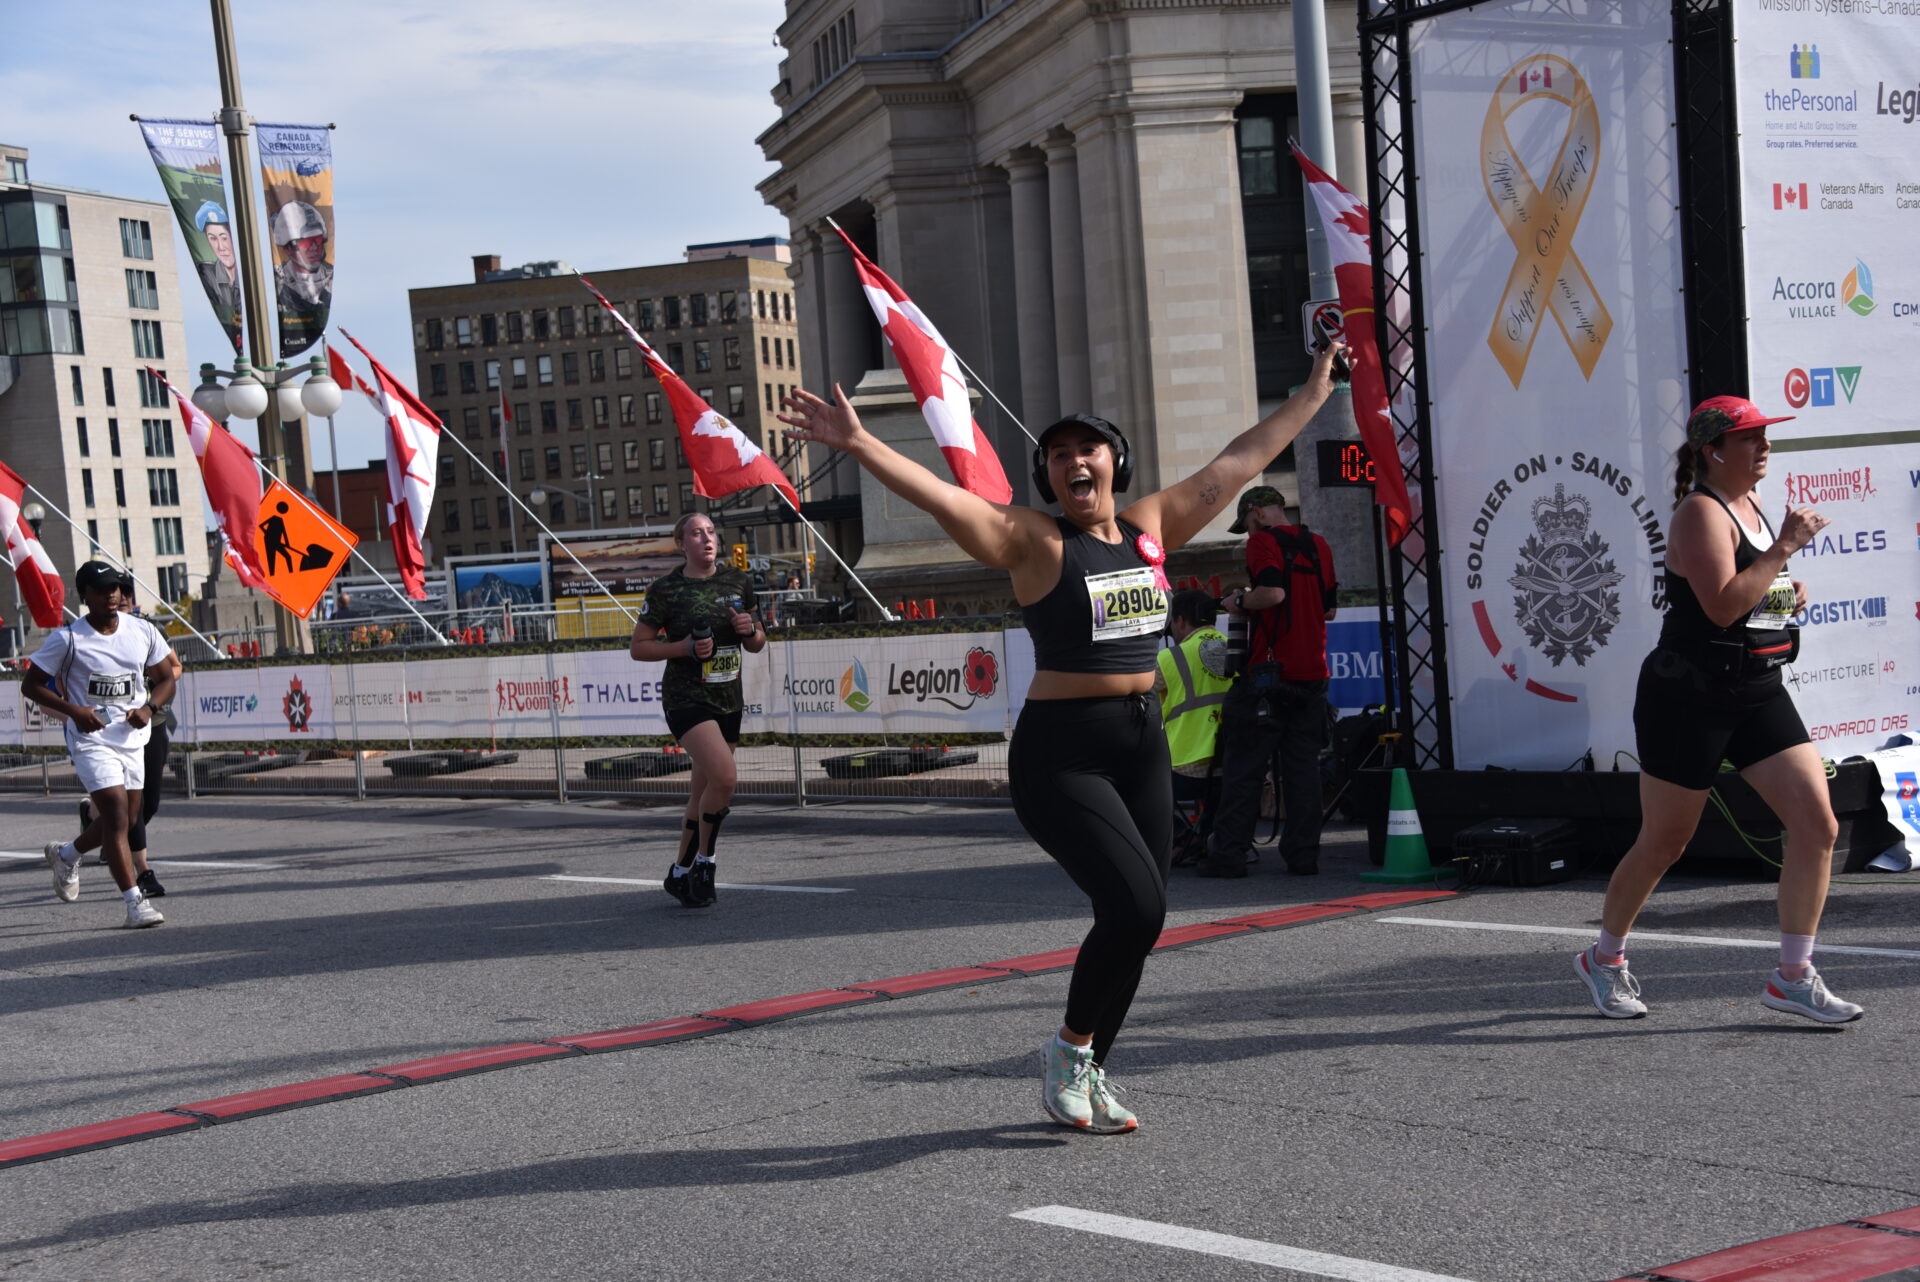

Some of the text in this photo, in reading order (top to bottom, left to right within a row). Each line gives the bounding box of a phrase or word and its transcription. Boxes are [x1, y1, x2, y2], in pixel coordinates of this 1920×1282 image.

[1764, 88, 1857, 112] thePersonal
[158, 127, 175, 138] THE
[177, 128, 214, 140] SERVICE
[160, 137, 204, 148] OF PEACE
[276, 132, 311, 142] CANADA
[268, 142, 322, 151] REMEMBERS
[1551, 135, 1588, 212] Troops
[1820, 183, 1884, 195] Veterans Affairs
[1895, 182, 1920, 194] Ancie
[1820, 198, 1853, 210] Canada
[1772, 276, 1836, 301] Accora
[1789, 305, 1837, 318] VILLAGE
[1784, 366, 1863, 409] CTV
[1796, 468, 1862, 504] Running
[1796, 475, 1850, 504] Room
[1467, 478, 1513, 591] SOLDIER
[1513, 454, 1547, 484] ON
[1571, 451, 1633, 498] SANS
[1802, 529, 1887, 558] HALES
[1105, 586, 1165, 618] 28902
[782, 674, 835, 696] Accora
[888, 661, 961, 702] Legion
[1786, 661, 1896, 686] ARCHITECTURE 49
[95, 682, 126, 696] 11700
[335, 694, 394, 706] ARCHITECTURE
[506, 677, 560, 712] Running
[200, 696, 245, 718] WESTJET
[794, 701, 834, 712] VILLAGE
[1808, 715, 1909, 742] EONARDO DRS
